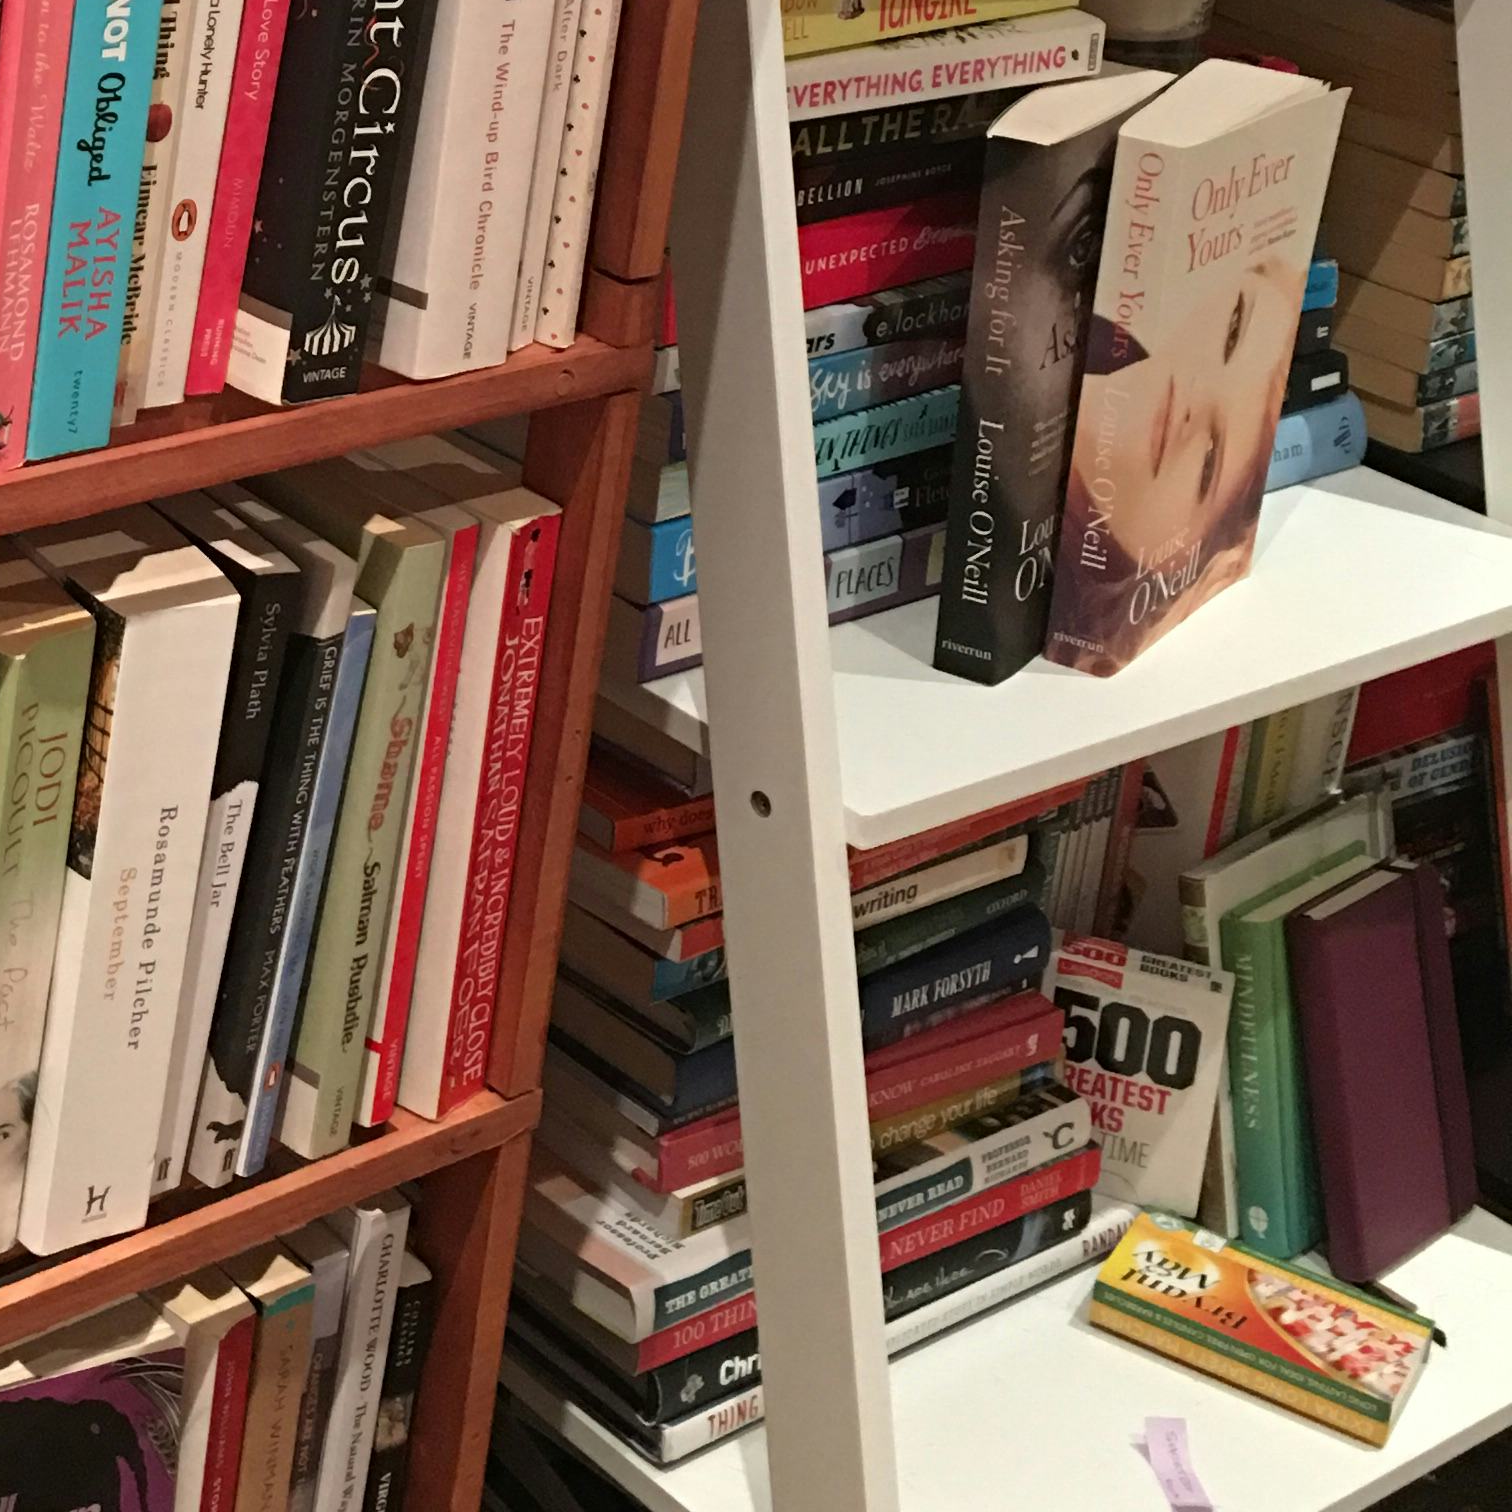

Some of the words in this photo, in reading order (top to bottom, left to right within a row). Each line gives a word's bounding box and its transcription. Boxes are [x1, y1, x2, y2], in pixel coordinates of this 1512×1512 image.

[497, 18, 516, 58] The
[552, 49, 569, 93] Dark
[931, 46, 1067, 89] EVERYTHING
[487, 60, 511, 143] Wind-up
[481, 147, 500, 192] Bird
[467, 195, 494, 291] Chronicle
[805, 237, 908, 275] UNEXPECTED
[986, 206, 1026, 306] Asking
[463, 303, 478, 360] VINTAGE
[987, 310, 1021, 347] for
[68, 369, 83, 434] twenty7
[971, 417, 1004, 504] Louise
[835, 556, 895, 599] PLACES
[252, 602, 281, 665] Sylvia
[941, 638, 992, 660] riverrun
[244, 668, 269, 721] Plath
[225, 799, 243, 830] The
[140, 803, 179, 952] Rosamunde
[216, 834, 236, 879] Bell
[210, 881, 222, 908] Jar
[853, 883, 918, 919] writing
[102, 866, 138, 1003] September
[127, 957, 159, 1052] Pilcher
[892, 986, 929, 1017] MARK
[934, 960, 992, 1003] FORSYTH
[1054, 986, 1201, 1090] 500
[890, 1220, 956, 1262] NEVER
[960, 1198, 1005, 1231] FIND
